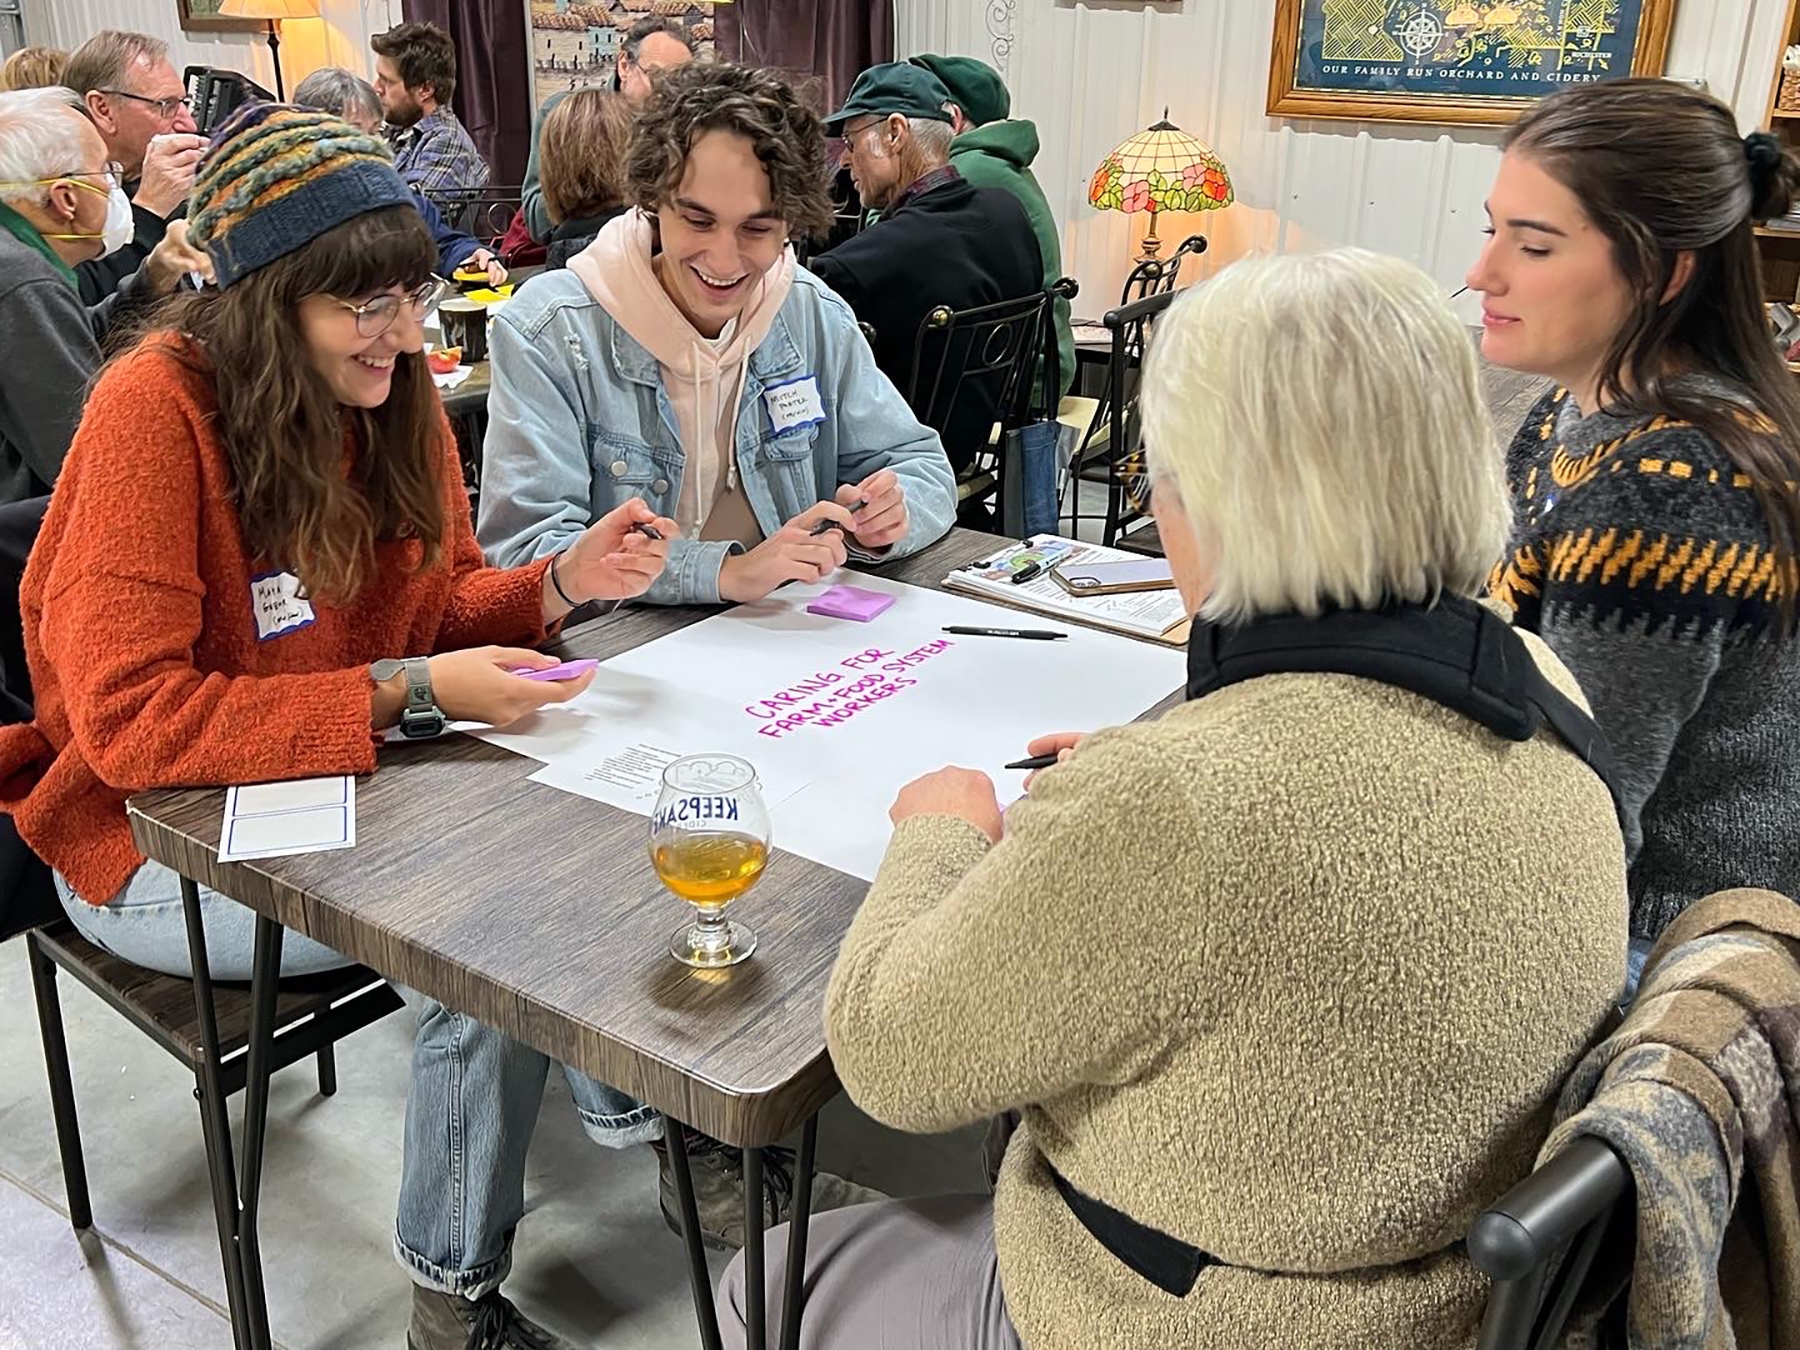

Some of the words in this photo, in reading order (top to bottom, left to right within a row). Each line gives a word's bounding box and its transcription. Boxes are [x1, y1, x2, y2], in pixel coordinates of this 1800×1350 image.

[1322, 65, 1348, 74] OUR
[1354, 66, 1401, 76] FAMILY
[1406, 68, 1433, 77] RUN
[1439, 69, 1504, 80] ORCHARD
[1510, 71, 1540, 81] AND
[1546, 73, 1601, 83] CIDERY
[745, 672, 844, 719] CARING
[840, 648, 895, 670] FOR
[758, 701, 834, 738] FARM
[834, 673, 885, 700] FOOD
[882, 639, 955, 673] SYSTEM
[812, 677, 917, 727] WORKERS
